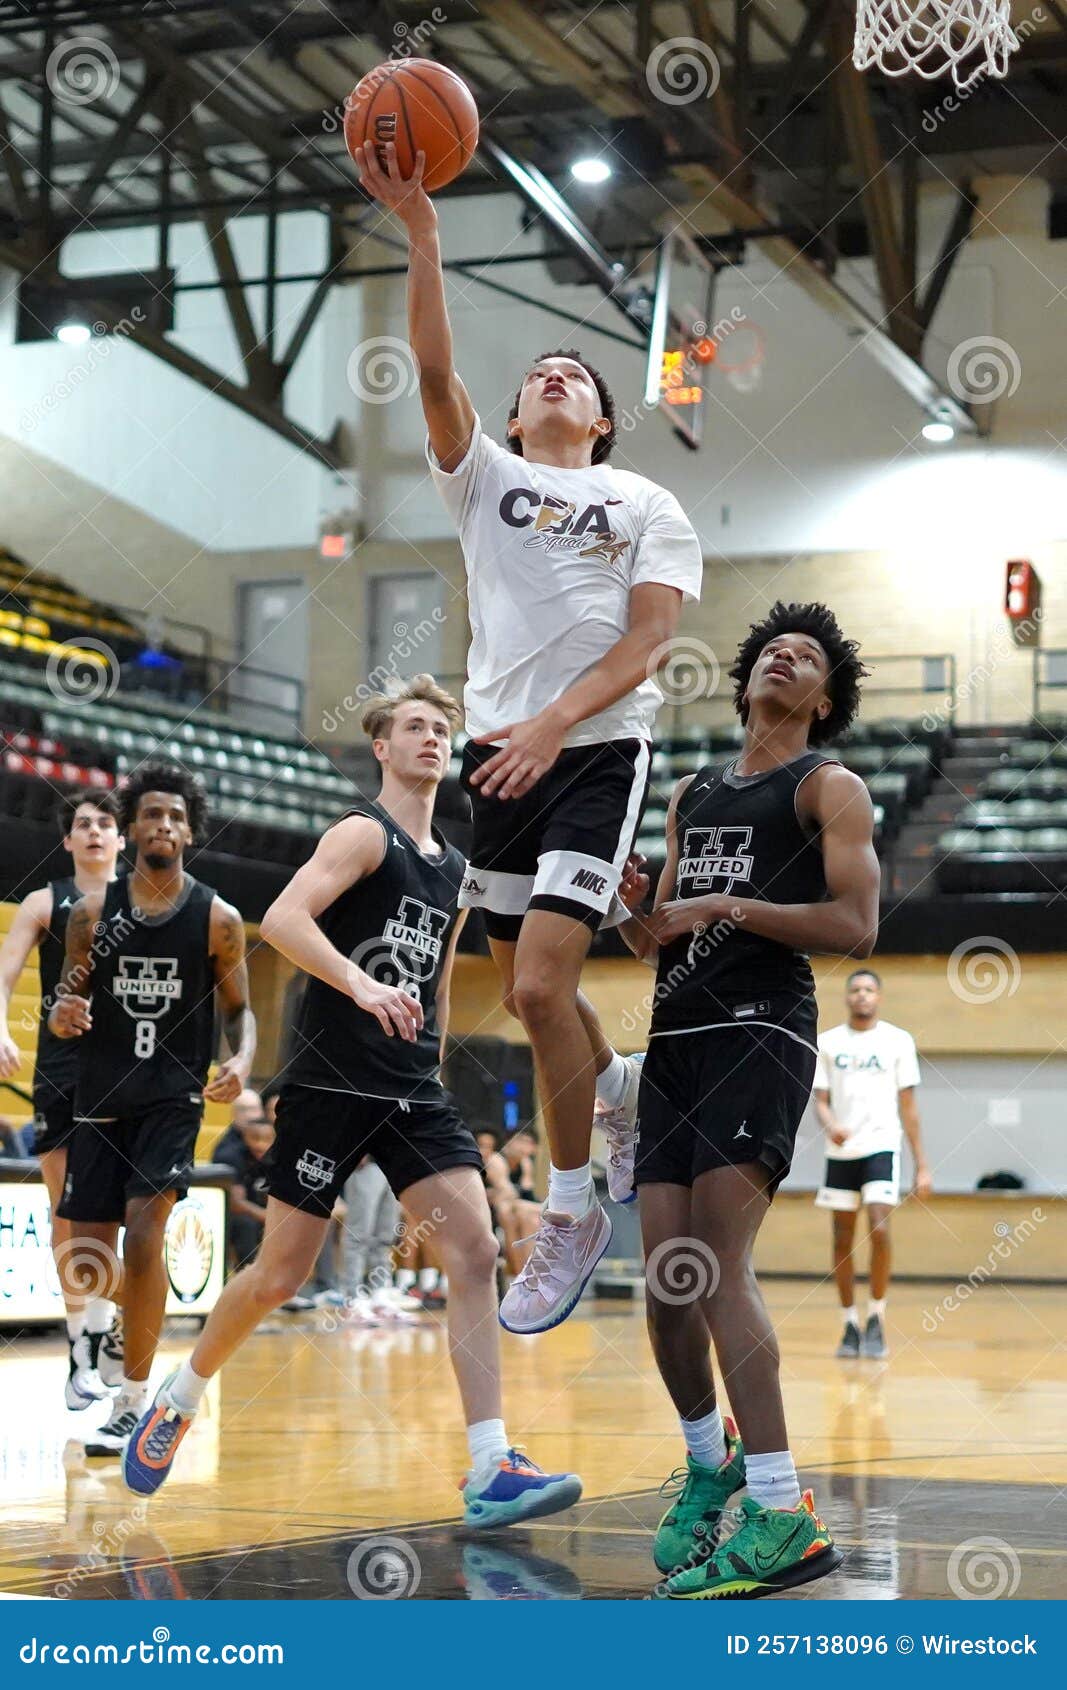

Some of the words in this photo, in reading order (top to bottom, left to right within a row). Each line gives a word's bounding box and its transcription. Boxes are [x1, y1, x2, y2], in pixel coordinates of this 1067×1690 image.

[523, 526, 593, 553] Squad
[579, 531, 631, 565] 24
[570, 868, 608, 896] NIKE
[391, 926, 439, 953] UNITE
[120, 982, 176, 993] UNITED
[134, 1020, 156, 1059] 8
[299, 1162, 332, 1180] UNITED
